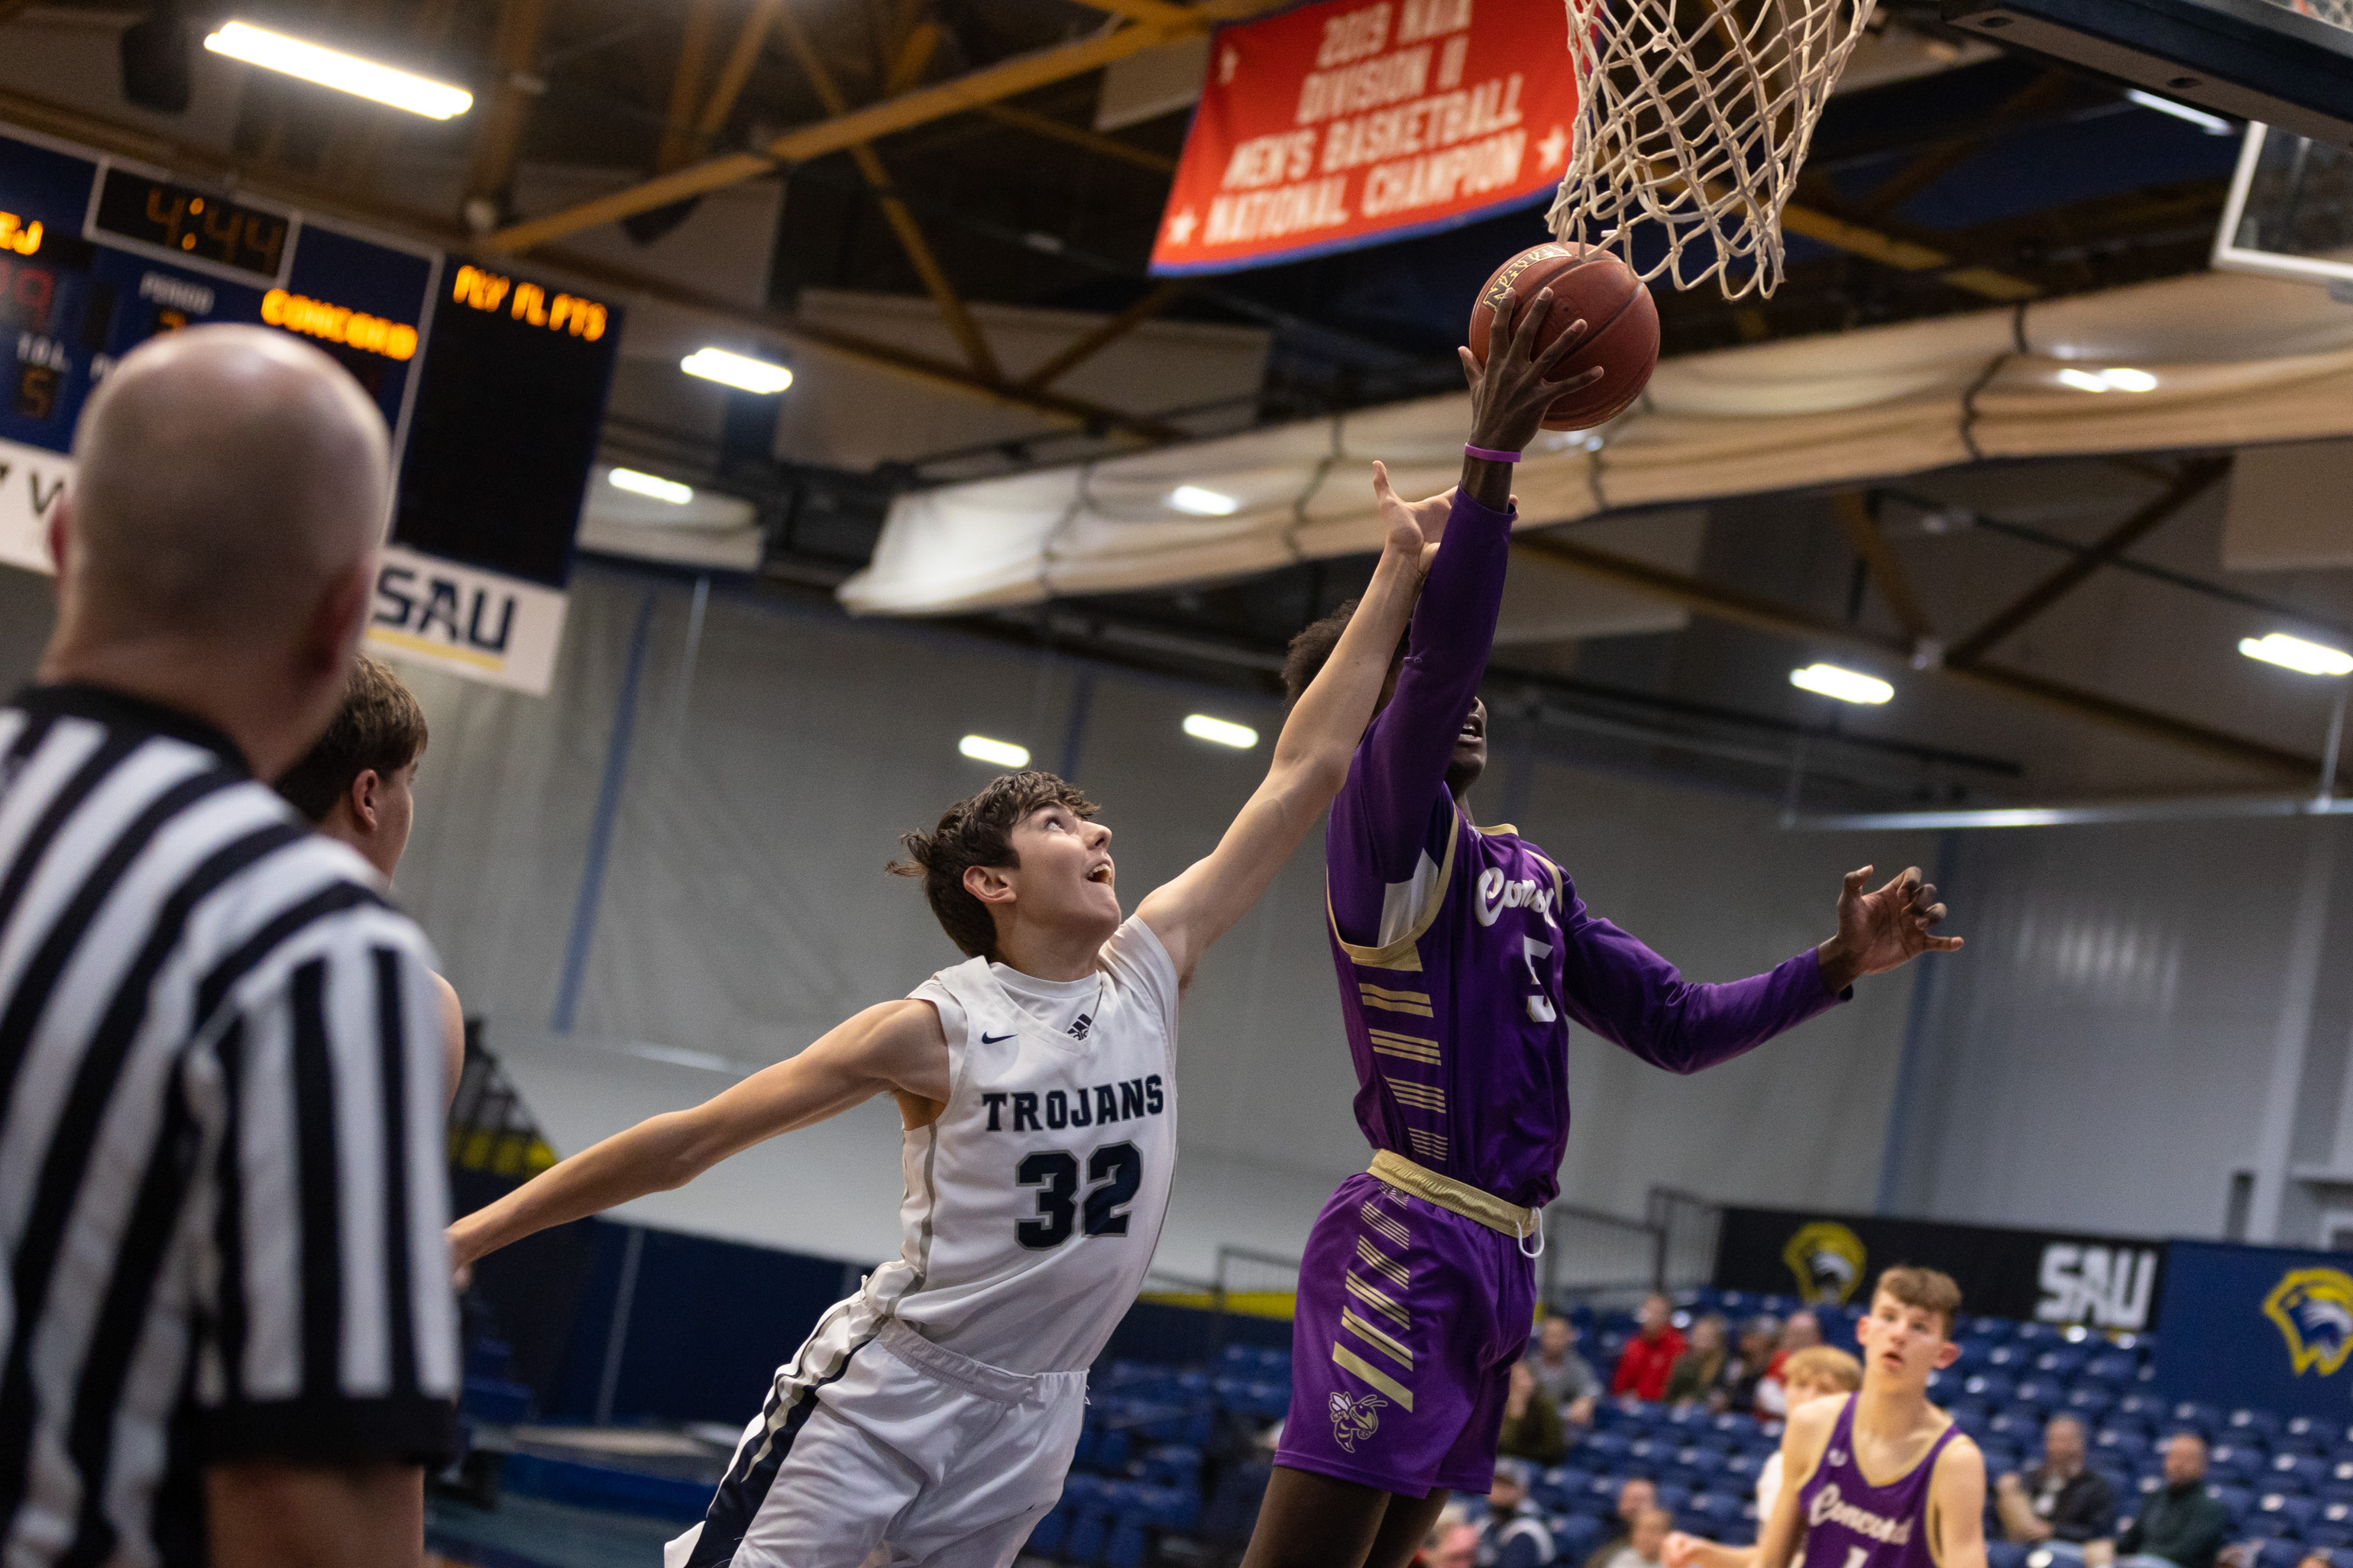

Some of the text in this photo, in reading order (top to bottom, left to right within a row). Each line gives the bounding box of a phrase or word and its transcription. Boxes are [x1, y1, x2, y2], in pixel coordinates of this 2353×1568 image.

[1296, 44, 1433, 124] DIVISION
[1222, 73, 1524, 189] MEN'S BASKETBALL
[146, 188, 283, 276] 4:44
[1202, 128, 1527, 246] NATIONAL CHAMPION
[373, 564, 519, 654] SAU
[1523, 933, 1558, 1023] 5
[981, 1073, 1164, 1133] TROJANS
[1015, 1139, 1144, 1252] 32
[2034, 1243, 2158, 1330] SAU
